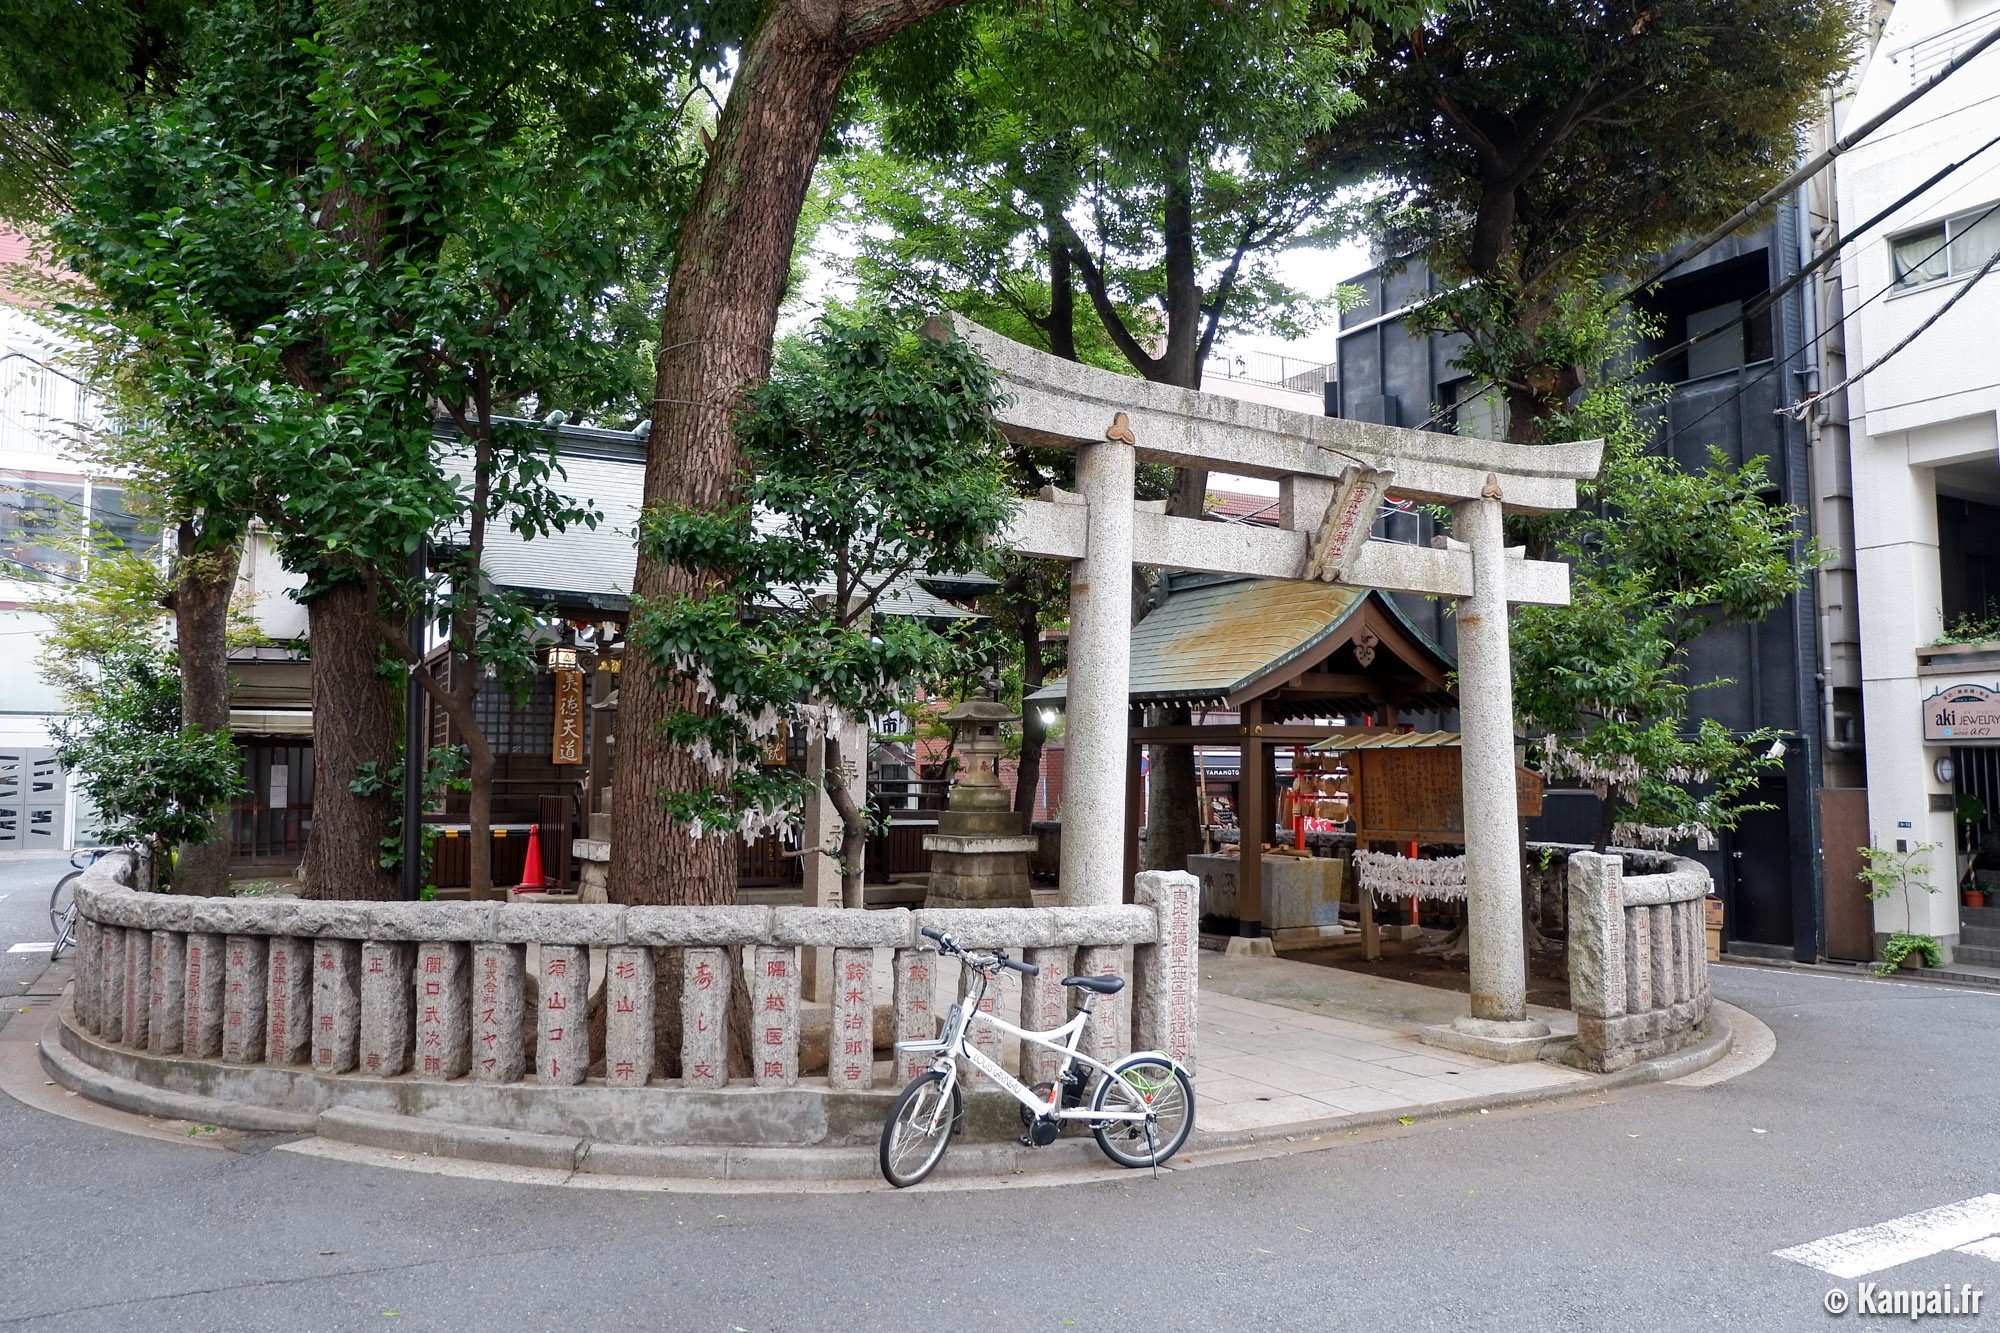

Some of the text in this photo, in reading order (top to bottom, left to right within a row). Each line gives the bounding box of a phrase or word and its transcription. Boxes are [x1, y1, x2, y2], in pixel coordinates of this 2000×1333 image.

[1935, 708, 2000, 726] aki JEWELRY
[548, 959, 566, 1078] 須山コト
[616, 961, 634, 1080] 杉山守
[973, 1053, 994, 1073] LOUIS
